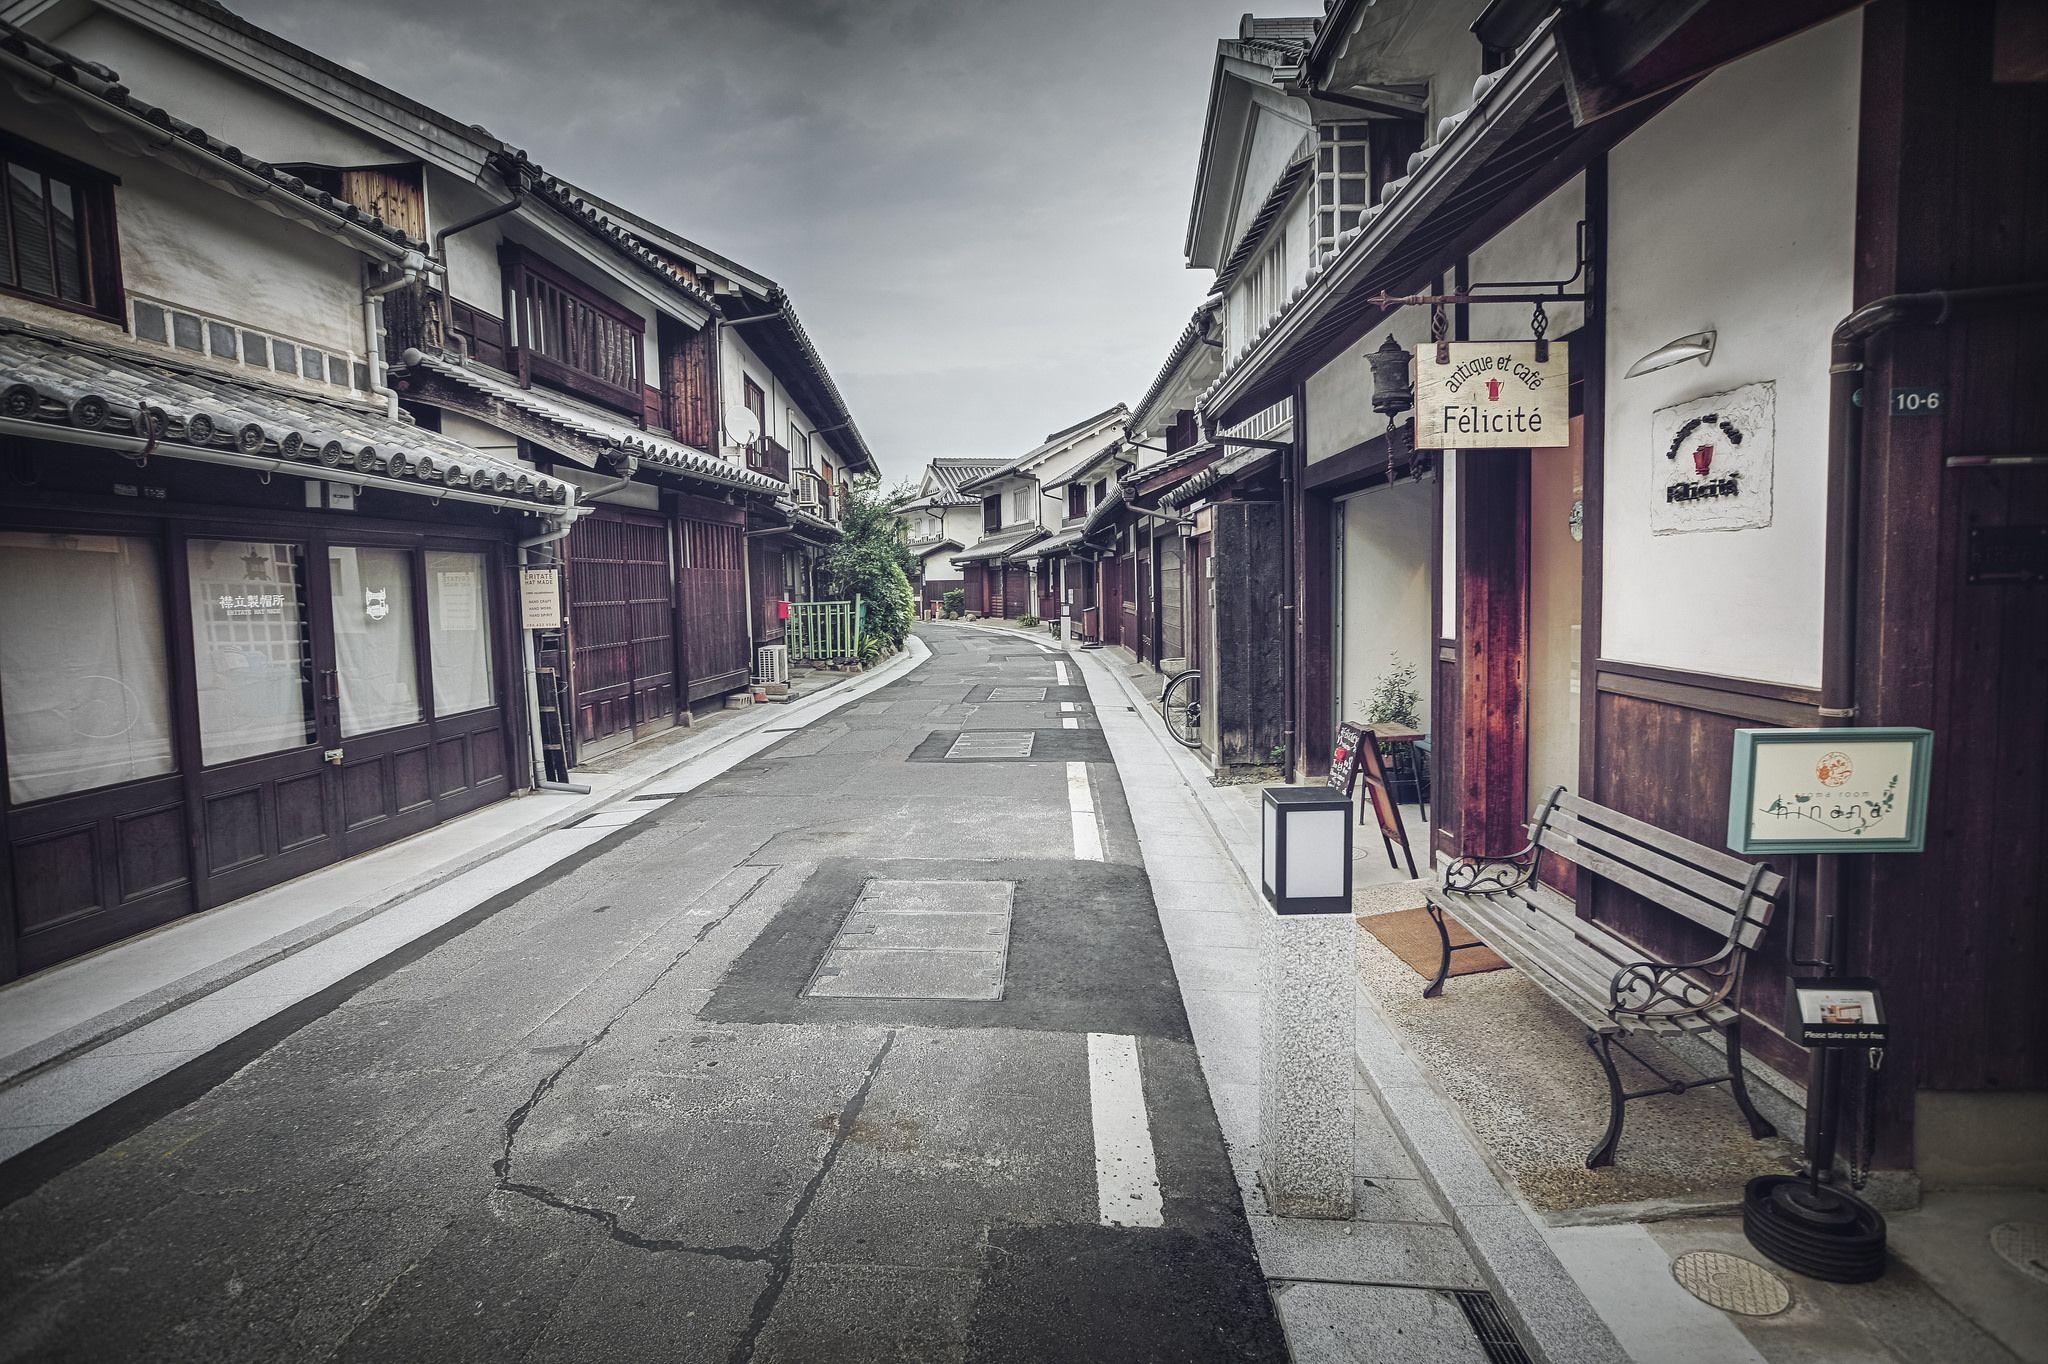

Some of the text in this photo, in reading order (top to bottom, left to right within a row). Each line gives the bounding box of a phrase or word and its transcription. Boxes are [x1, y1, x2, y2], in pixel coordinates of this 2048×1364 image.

[1445, 354, 1545, 393] antique et café
[1896, 392, 1940, 410] 10-6
[1444, 405, 1542, 434] Félicité
[1804, 1031, 1827, 1039] Please
[1827, 1031, 1843, 1039] take
[1859, 1031, 1869, 1039] for
